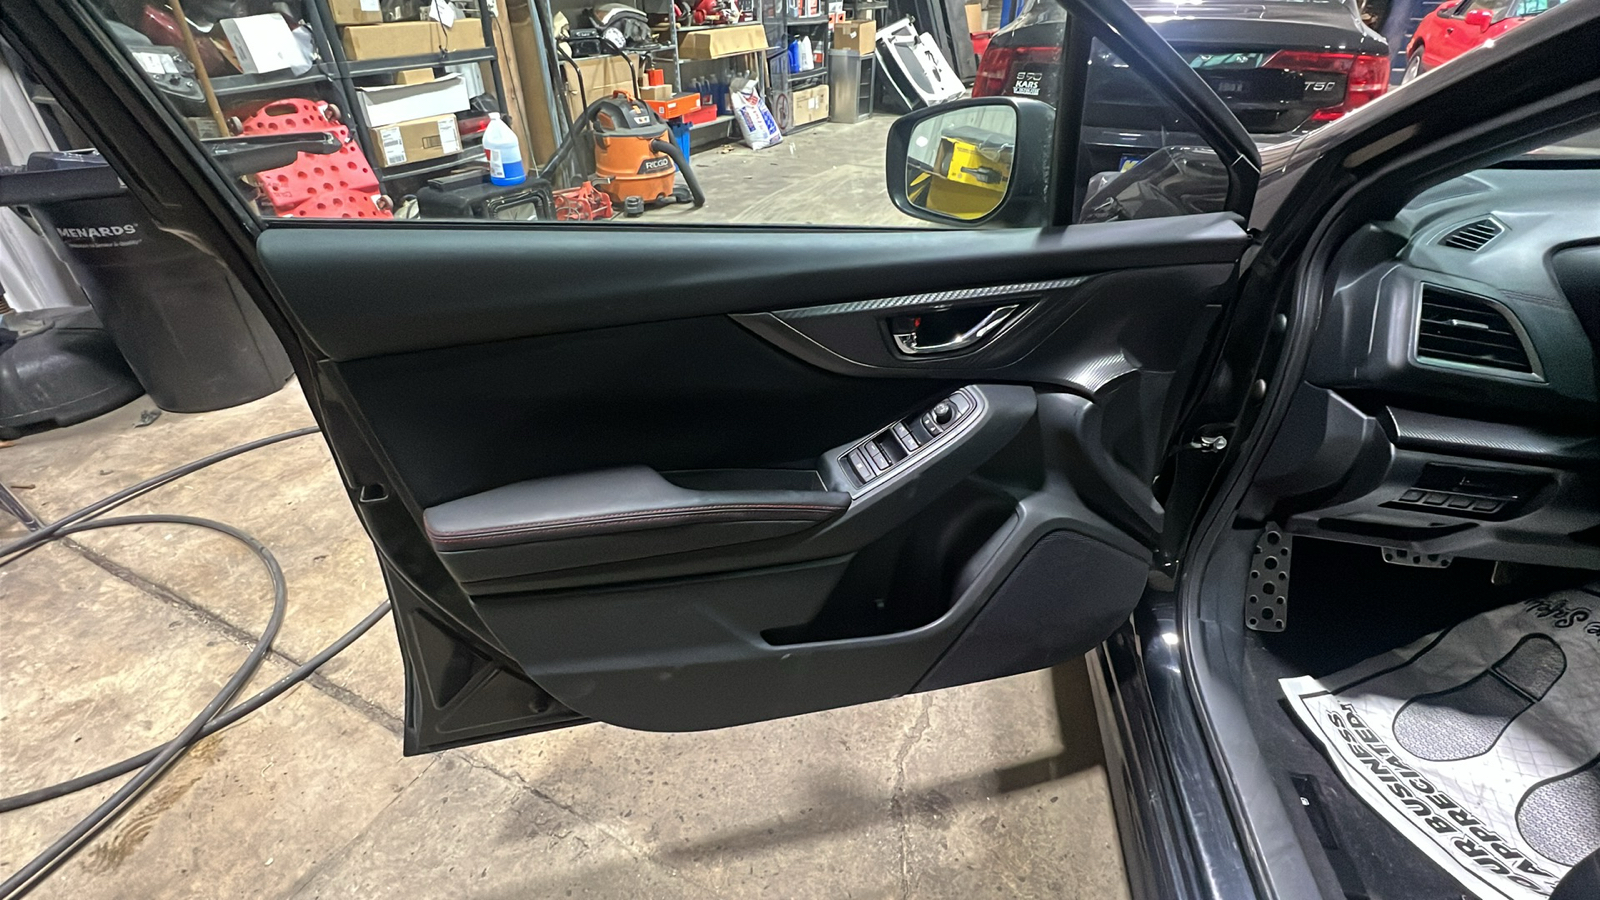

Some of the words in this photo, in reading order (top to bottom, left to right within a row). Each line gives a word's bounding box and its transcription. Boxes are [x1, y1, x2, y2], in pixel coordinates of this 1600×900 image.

[1015, 80, 1039, 89] KARS
[56, 224, 136, 238] MENARDS
[1327, 712, 1458, 834] BUSINESS
[1454, 838, 1551, 897] OUR
